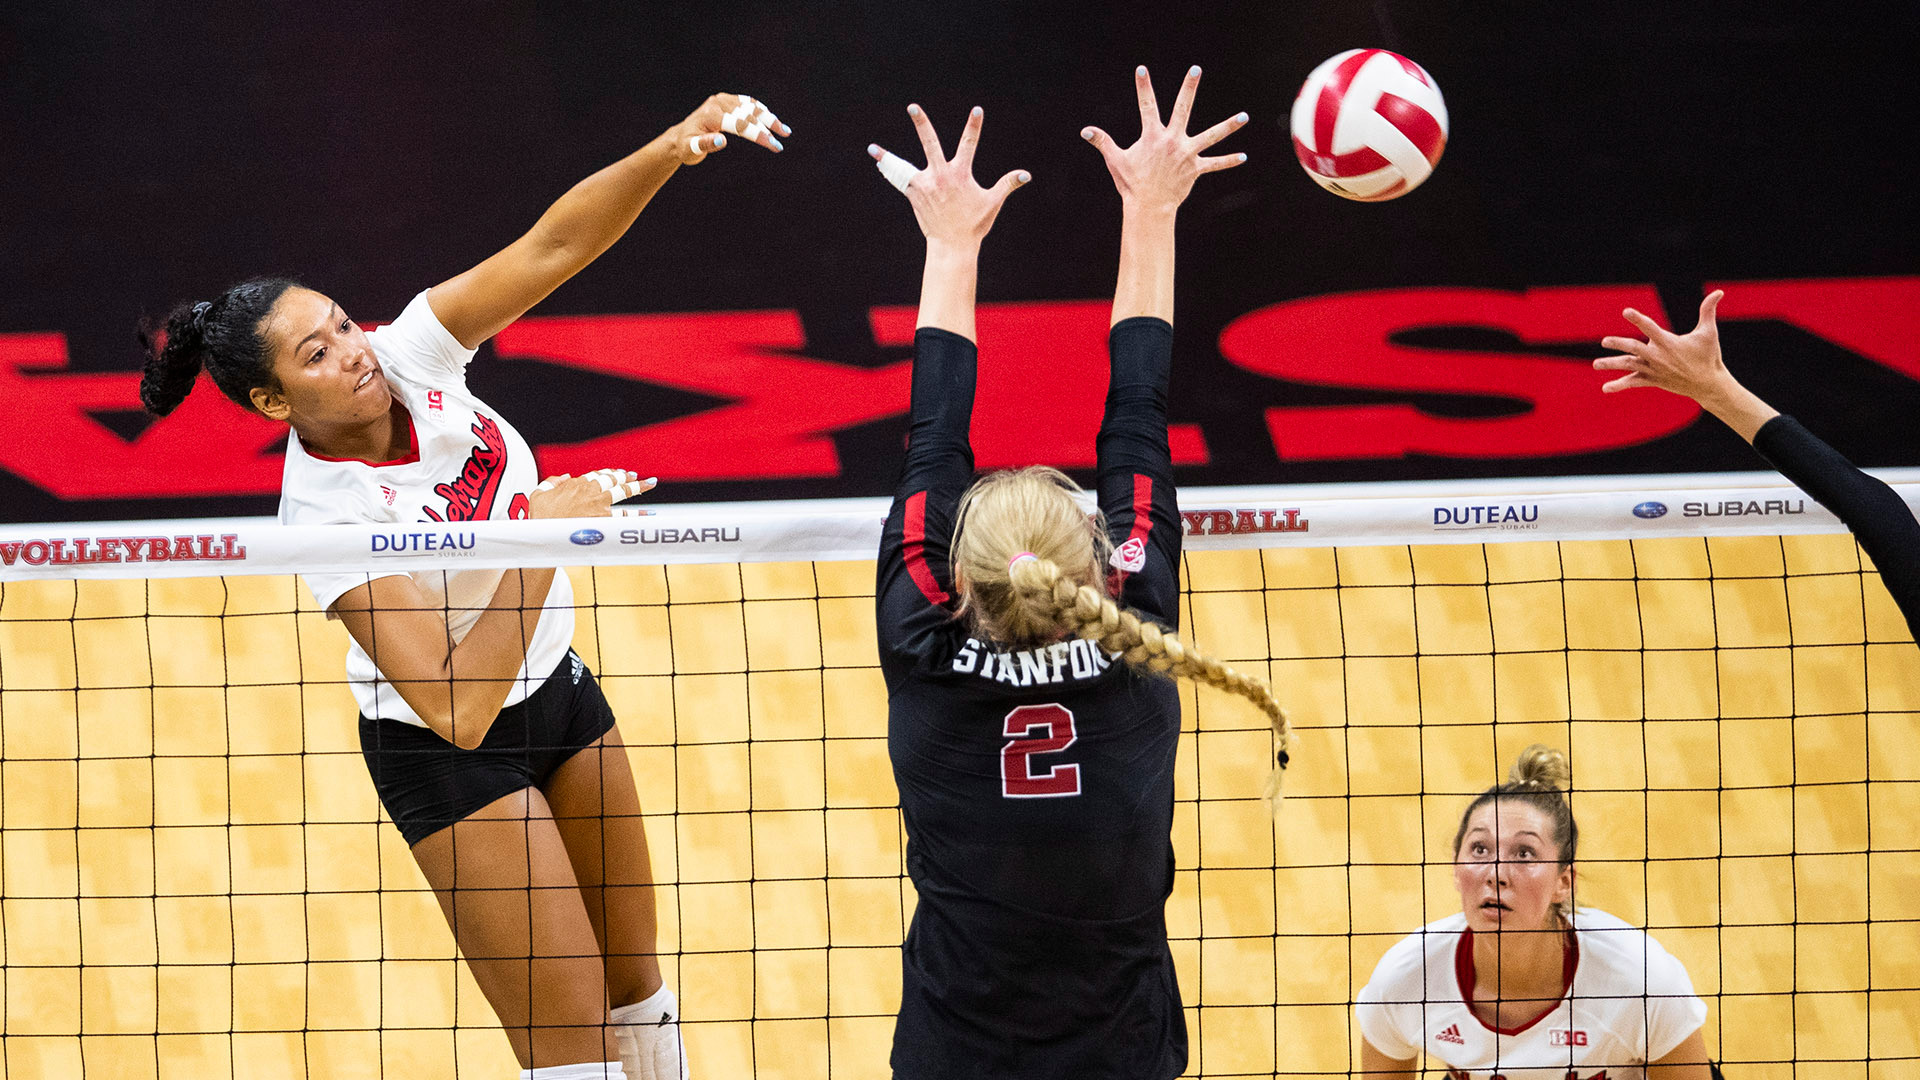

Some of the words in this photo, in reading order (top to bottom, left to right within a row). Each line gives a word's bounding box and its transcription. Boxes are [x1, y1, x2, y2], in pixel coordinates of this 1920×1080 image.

[1434, 505, 1538, 525] DUTEAU
[1683, 500, 1804, 518] SUBARU
[371, 532, 475, 552] DUTEAU
[620, 527, 740, 545] SUBARU
[0, 534, 247, 566] VOLLEYBALL
[1001, 702, 1082, 798] 2
